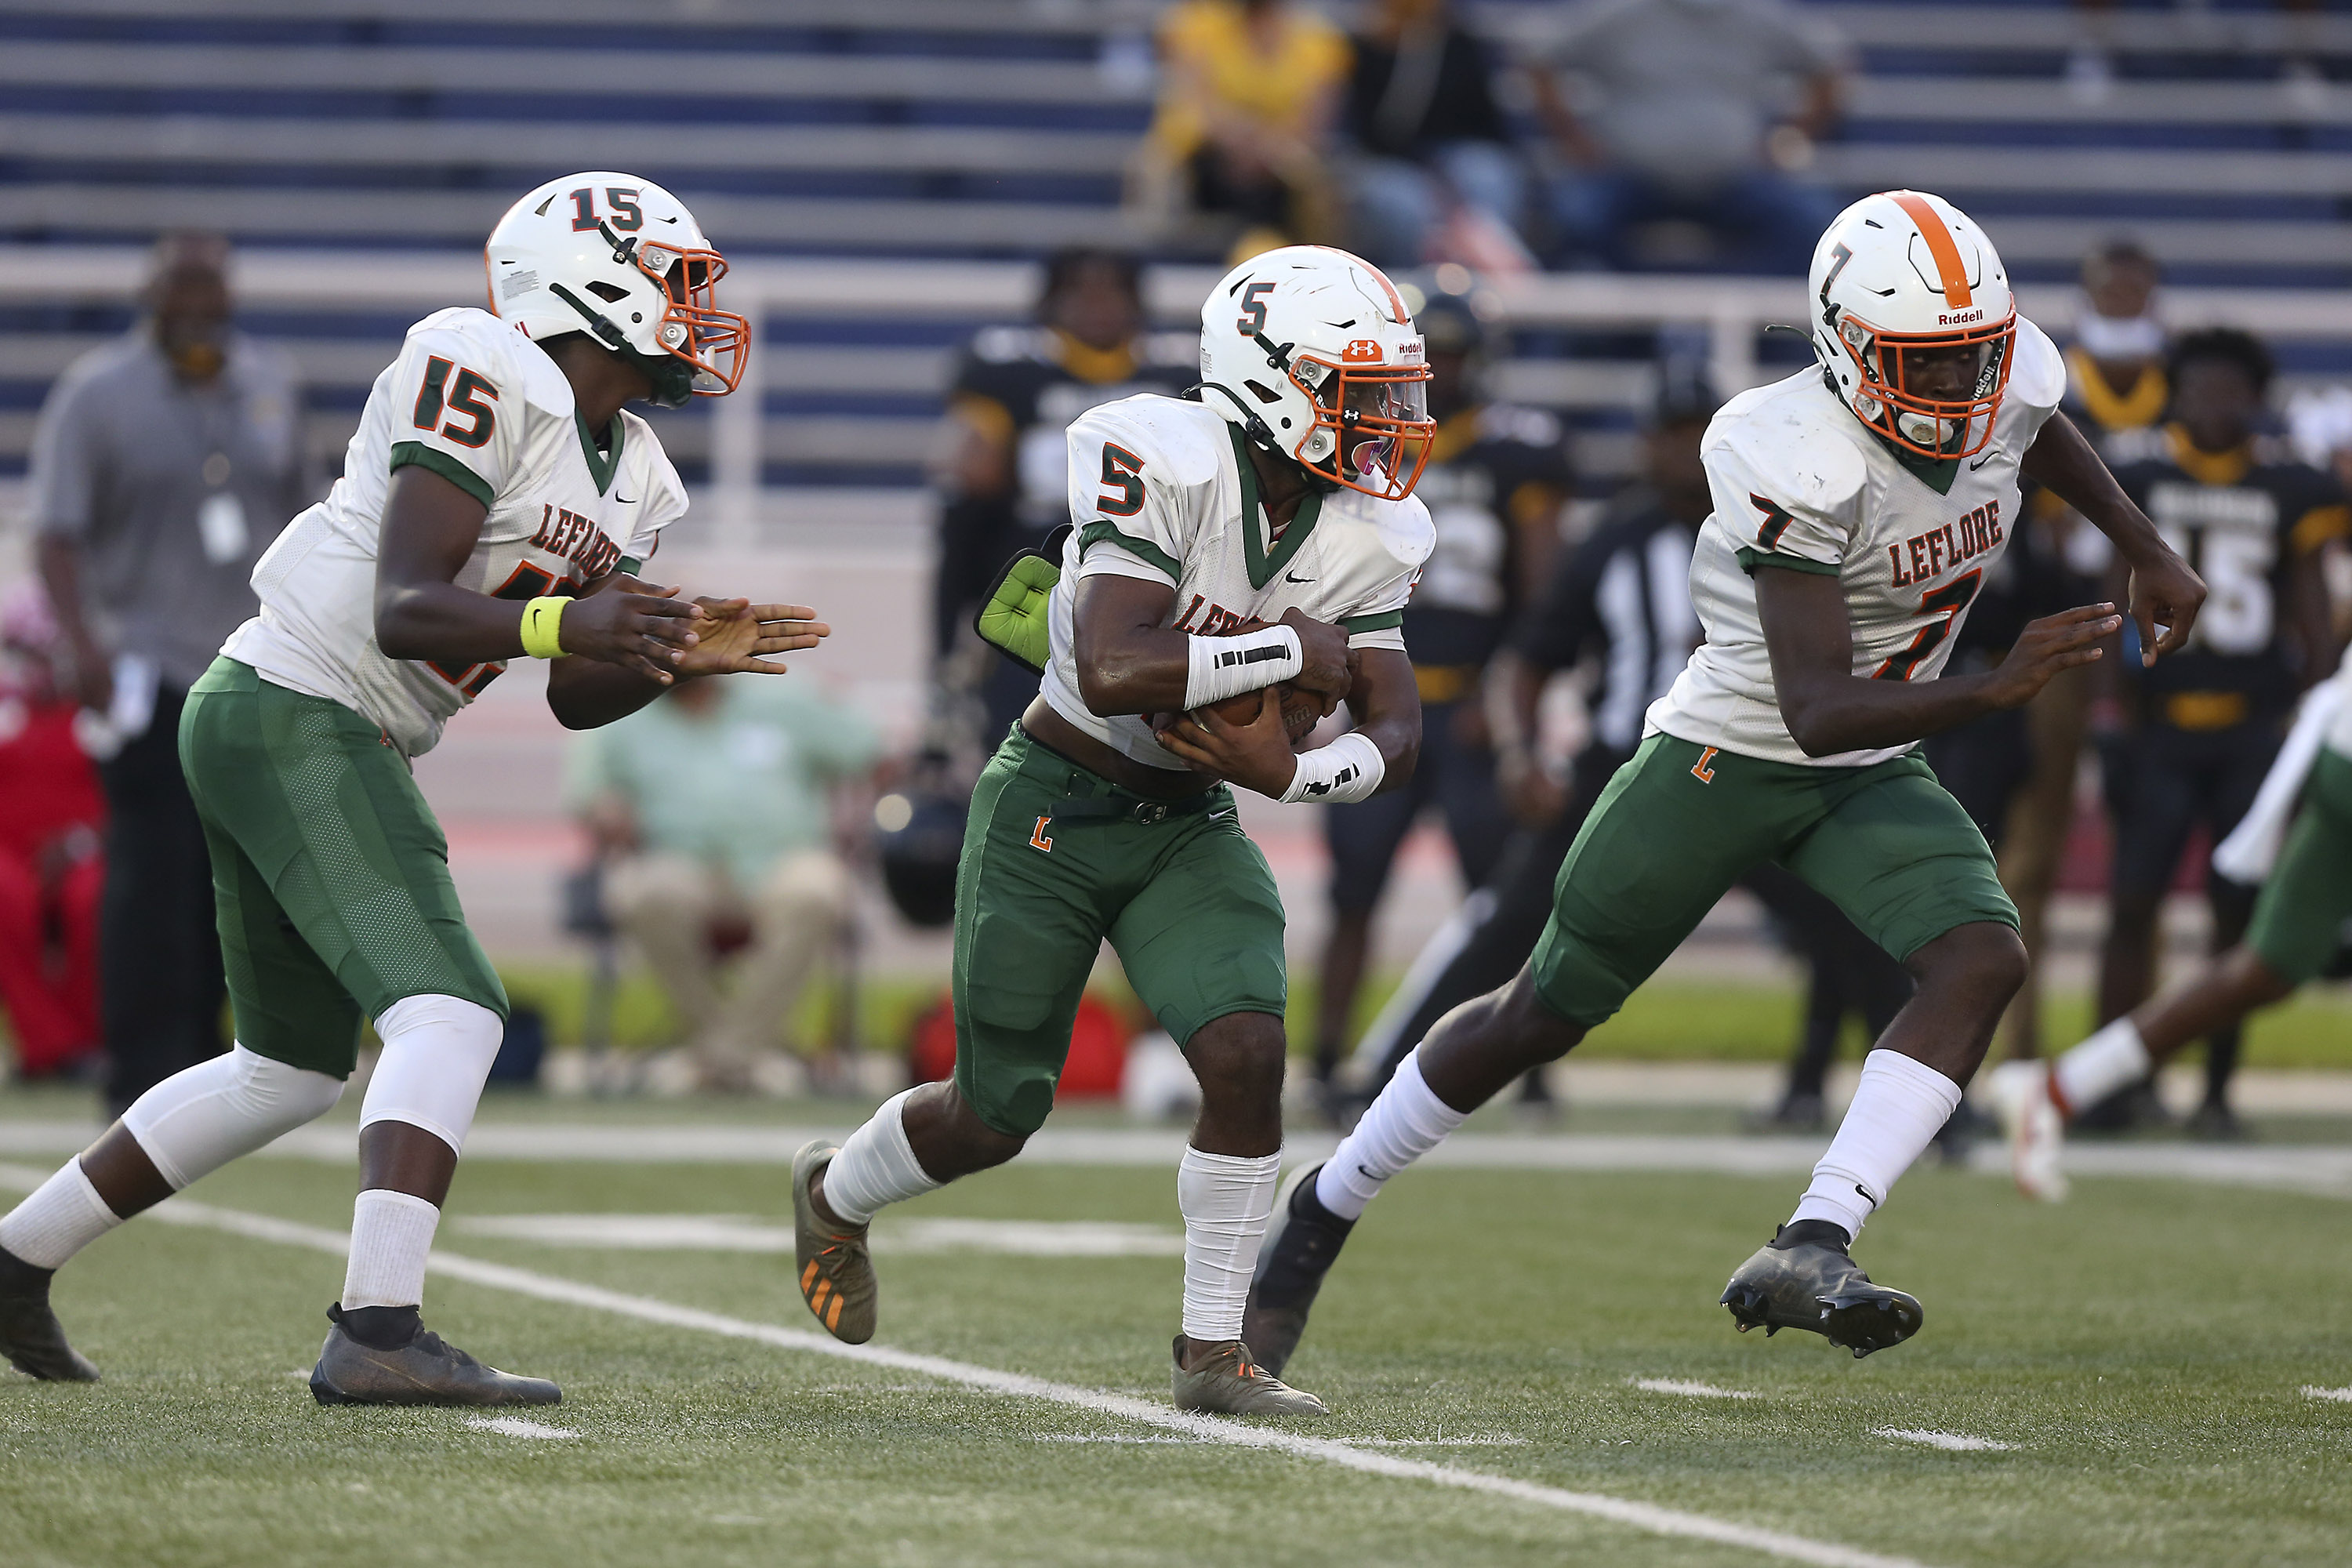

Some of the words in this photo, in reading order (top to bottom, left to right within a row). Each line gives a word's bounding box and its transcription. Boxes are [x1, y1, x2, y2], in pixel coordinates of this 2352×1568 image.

[570, 187, 644, 233] 15
[1820, 241, 1853, 297] 7
[1236, 281, 1276, 337] 5
[1938, 309, 1984, 325] Riddell
[413, 354, 499, 449] 15
[1097, 441, 1146, 517] 5
[1748, 491, 1795, 550] 7
[1888, 499, 2004, 588] LEFLORE
[1869, 566, 1984, 684] 7
[1690, 746, 1719, 784] L
[1029, 815, 1054, 853] L
